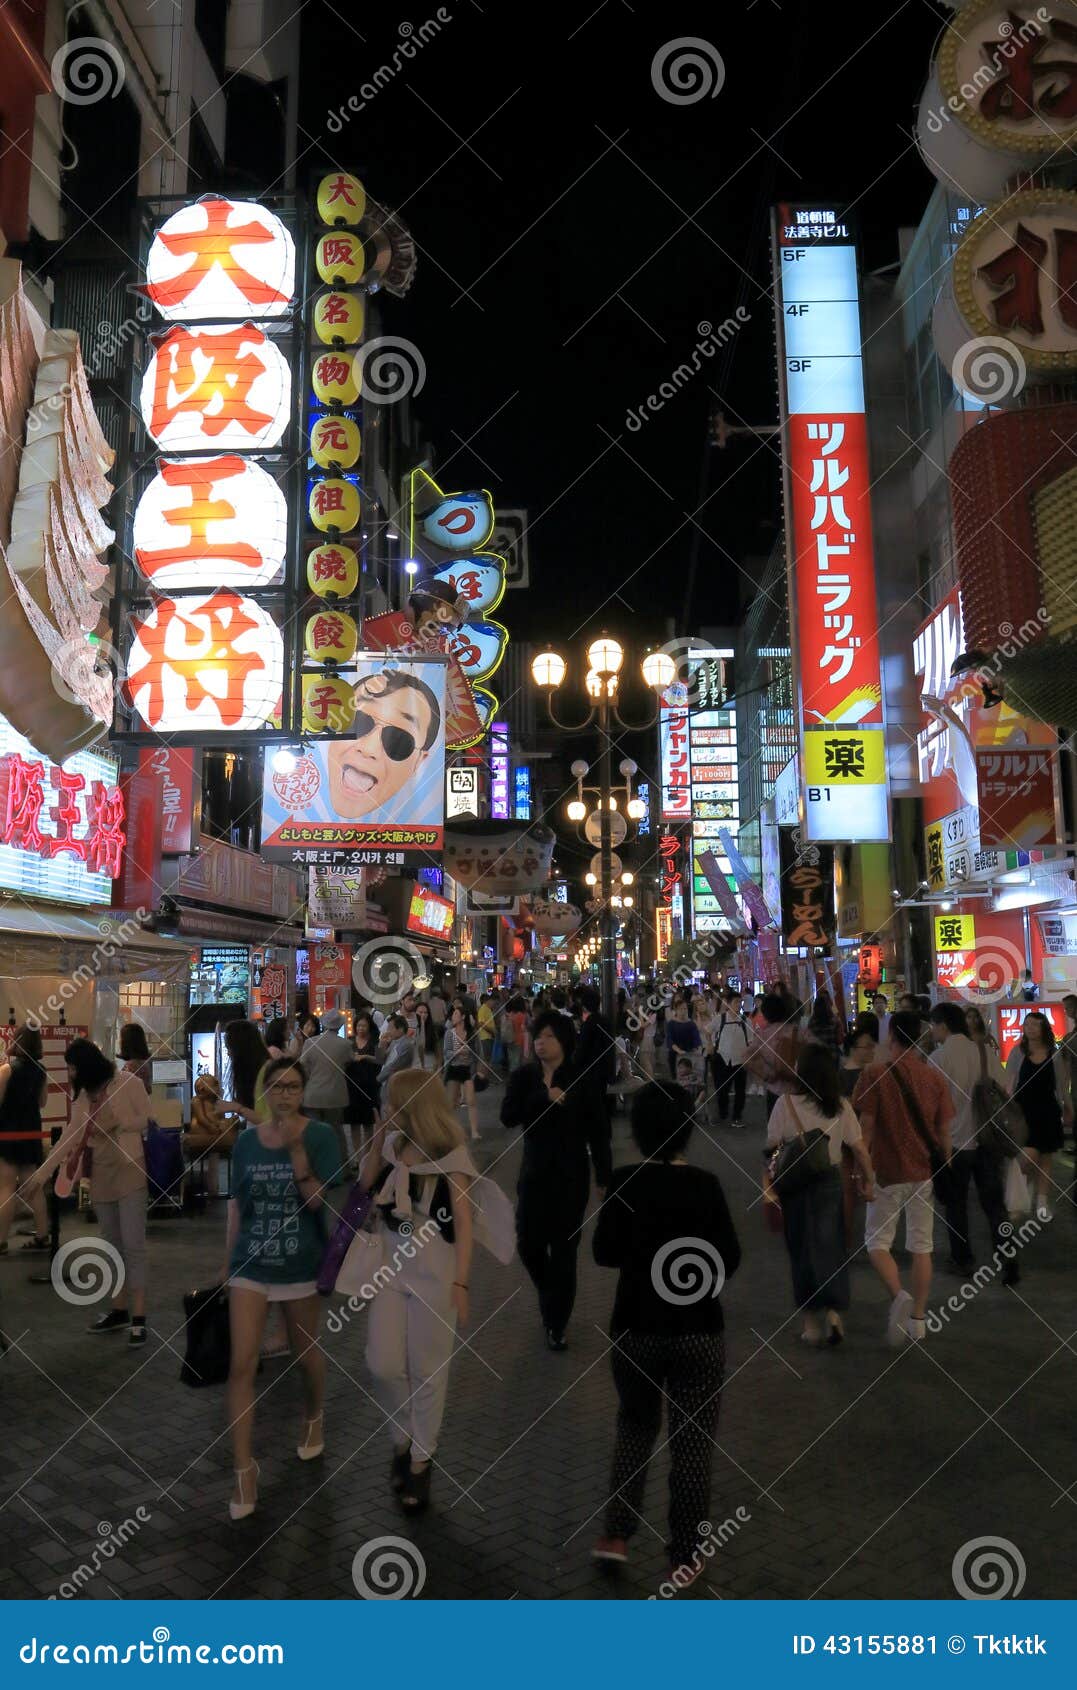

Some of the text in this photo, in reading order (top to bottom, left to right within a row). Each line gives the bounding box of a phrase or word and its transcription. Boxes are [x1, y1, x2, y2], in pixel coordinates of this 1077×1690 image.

[796, 211, 836, 224] 道頓堀
[784, 225, 849, 239] 法善寺ビル
[783, 250, 806, 262] 5F
[786, 305, 809, 317] 4F
[788, 360, 812, 373] 3F
[806, 423, 861, 684] ツルハドラッグ
[669, 710, 689, 809] ジャンカラ
[824, 738, 865, 778] 薬
[979, 755, 1050, 776] ツルハ
[808, 788, 832, 802] B1
[981, 781, 1038, 798] ドラッグ
[948, 817, 964, 841] くすり
[928, 831, 944, 883] 薬
[940, 919, 962, 947] 薬
[937, 953, 965, 966] ツルハ
[53, 1027, 79, 1036] MENU
